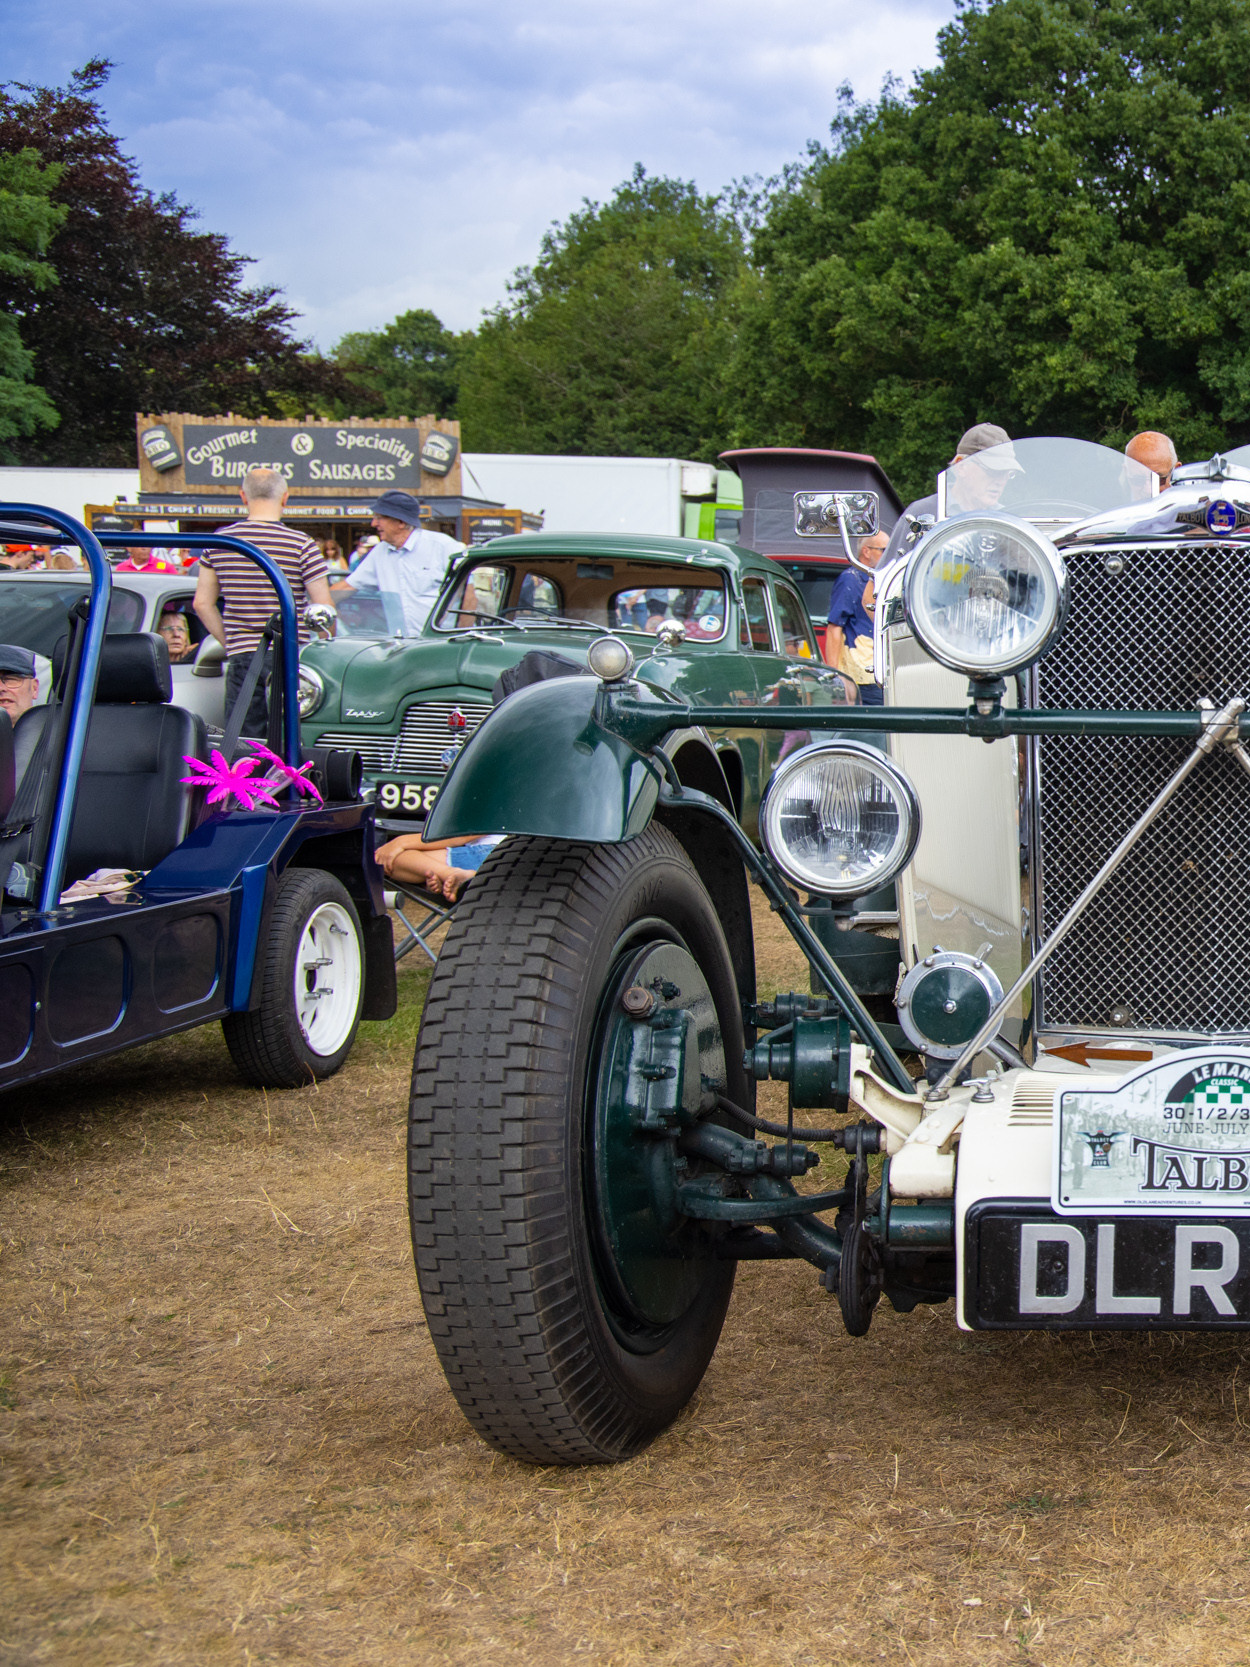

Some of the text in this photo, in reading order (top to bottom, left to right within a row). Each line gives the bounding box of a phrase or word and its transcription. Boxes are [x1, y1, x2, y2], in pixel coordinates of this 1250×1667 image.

[187, 429, 258, 465] Gourmet
[293, 434, 312, 454] &
[336, 430, 414, 467] Speciality
[309, 459, 396, 480] SAUSAGES
[1178, 512, 1204, 524] TALBOT
[1192, 1065, 1211, 1084] LE
[1210, 1078, 1240, 1086] CLASSIC
[1162, 1122, 1250, 1134] JUNE-JULY
[1019, 1223, 1240, 1316] DLR
